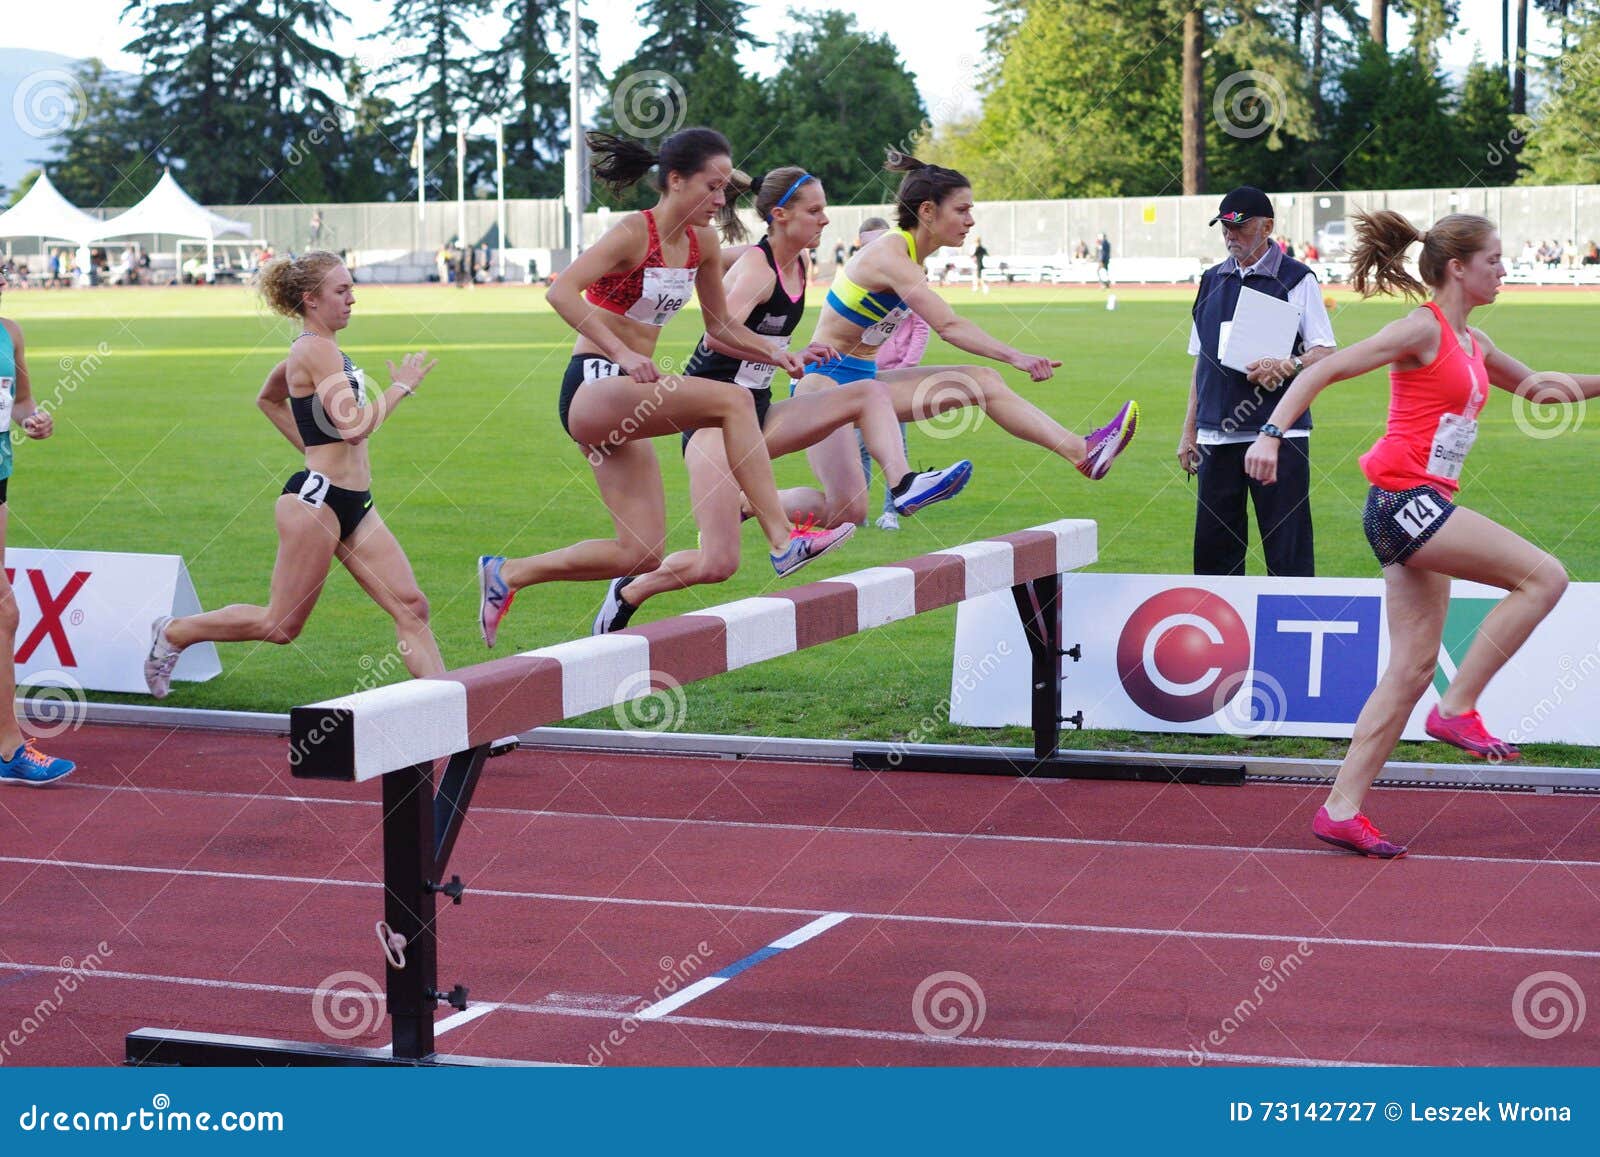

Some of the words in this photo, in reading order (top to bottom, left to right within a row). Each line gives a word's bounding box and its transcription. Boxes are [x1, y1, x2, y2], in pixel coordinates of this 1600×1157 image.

[654, 294, 683, 312] Yee
[302, 475, 324, 505] 2
[1402, 497, 1435, 529] 14
[4, 568, 92, 668] X
